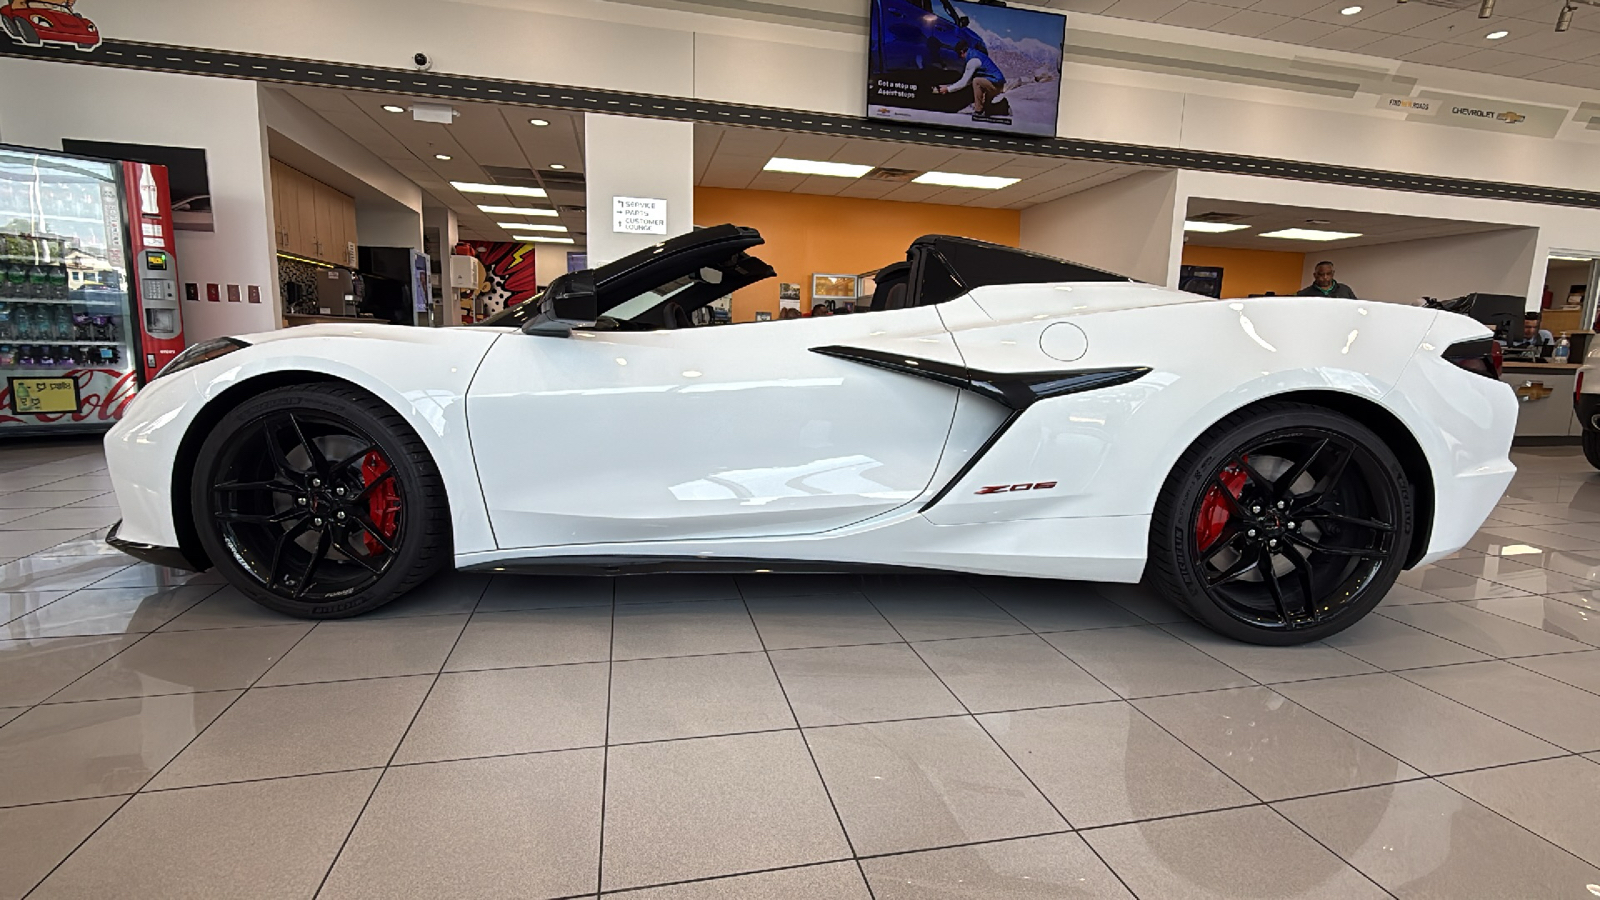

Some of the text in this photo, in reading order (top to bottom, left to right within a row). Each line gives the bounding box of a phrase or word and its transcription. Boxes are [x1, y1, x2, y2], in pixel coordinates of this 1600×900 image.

[1389, 98, 1401, 106] FIND
[1412, 102, 1429, 111] ROADS
[1452, 106, 1495, 119] CHEVROLET
[625, 201, 656, 209] SERVICE
